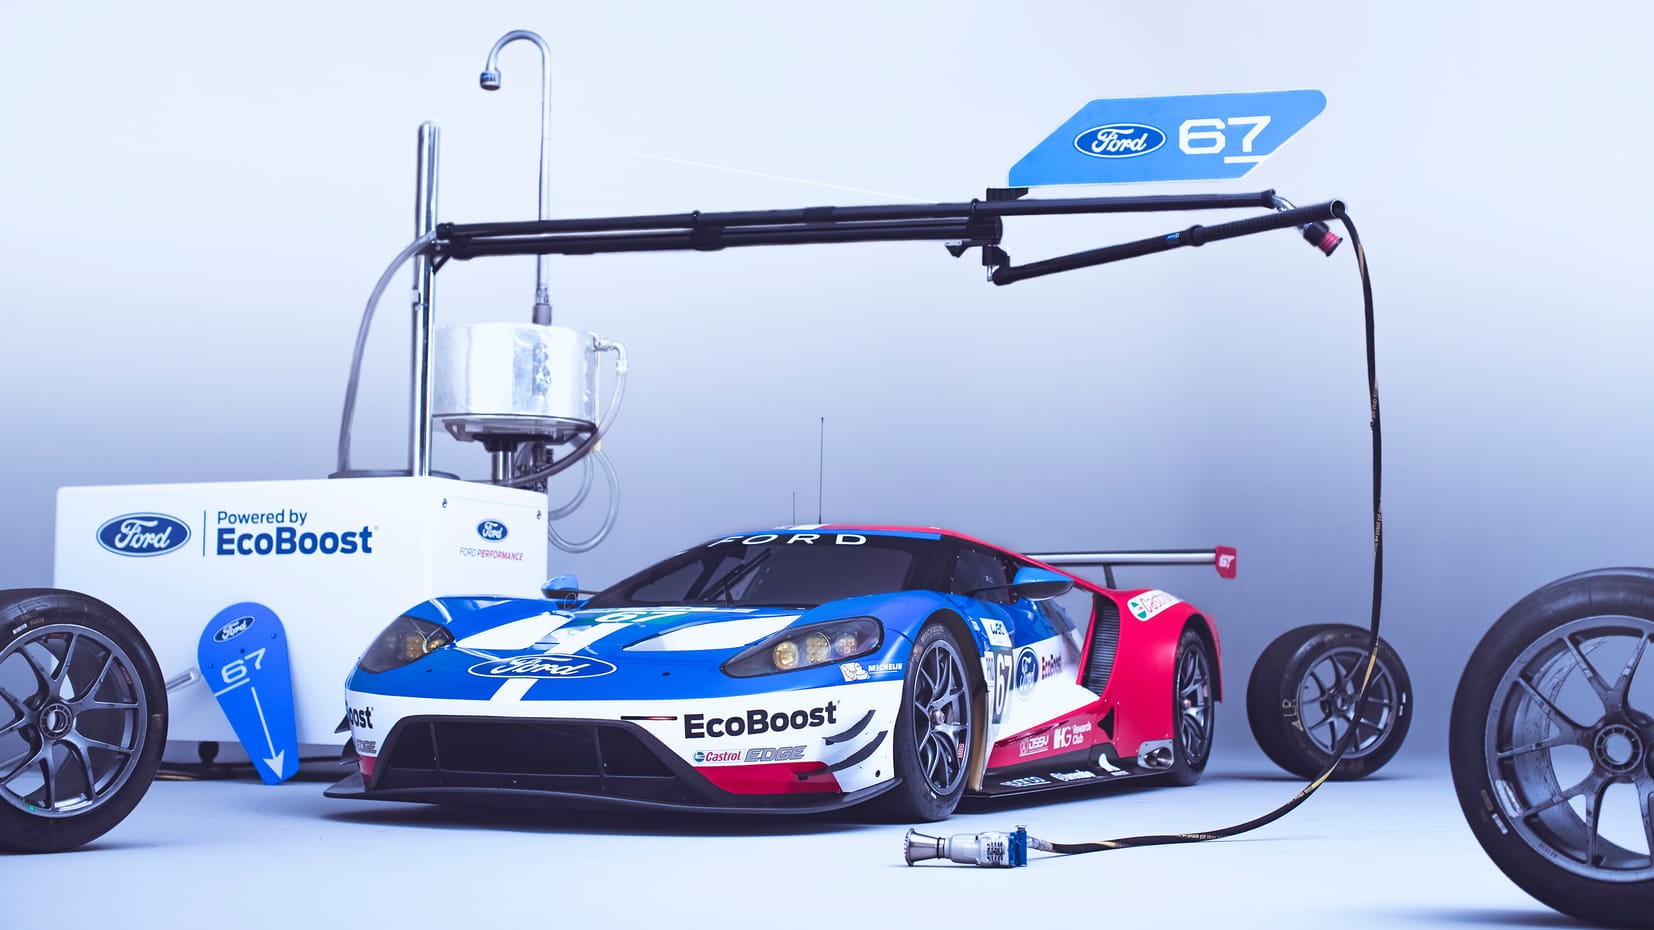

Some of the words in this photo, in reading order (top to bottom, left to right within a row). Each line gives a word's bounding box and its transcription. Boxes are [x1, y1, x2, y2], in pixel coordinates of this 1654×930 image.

[1091, 128, 1149, 152] Ford
[1179, 115, 1271, 155] 67
[217, 510, 286, 525] Powered
[289, 509, 308, 526] by
[114, 518, 171, 549] Ford
[216, 526, 373, 556] EcoBoost
[482, 521, 504, 539] Ford
[707, 533, 867, 548] FORD
[460, 546, 477, 557] FORD
[477, 548, 524, 561] PERFORMANCE
[594, 611, 689, 624] 67
[221, 619, 248, 640] Ford
[221, 647, 266, 684] 67
[490, 655, 592, 676] Ford
[867, 663, 903, 673] MICHELIN
[1020, 656, 1037, 690] Ford
[995, 652, 1013, 716] 67
[684, 701, 837, 739] EcoBoost
[1053, 727, 1072, 750] IHG
[705, 751, 741, 762] Castrol
[744, 745, 807, 762] EDGE
